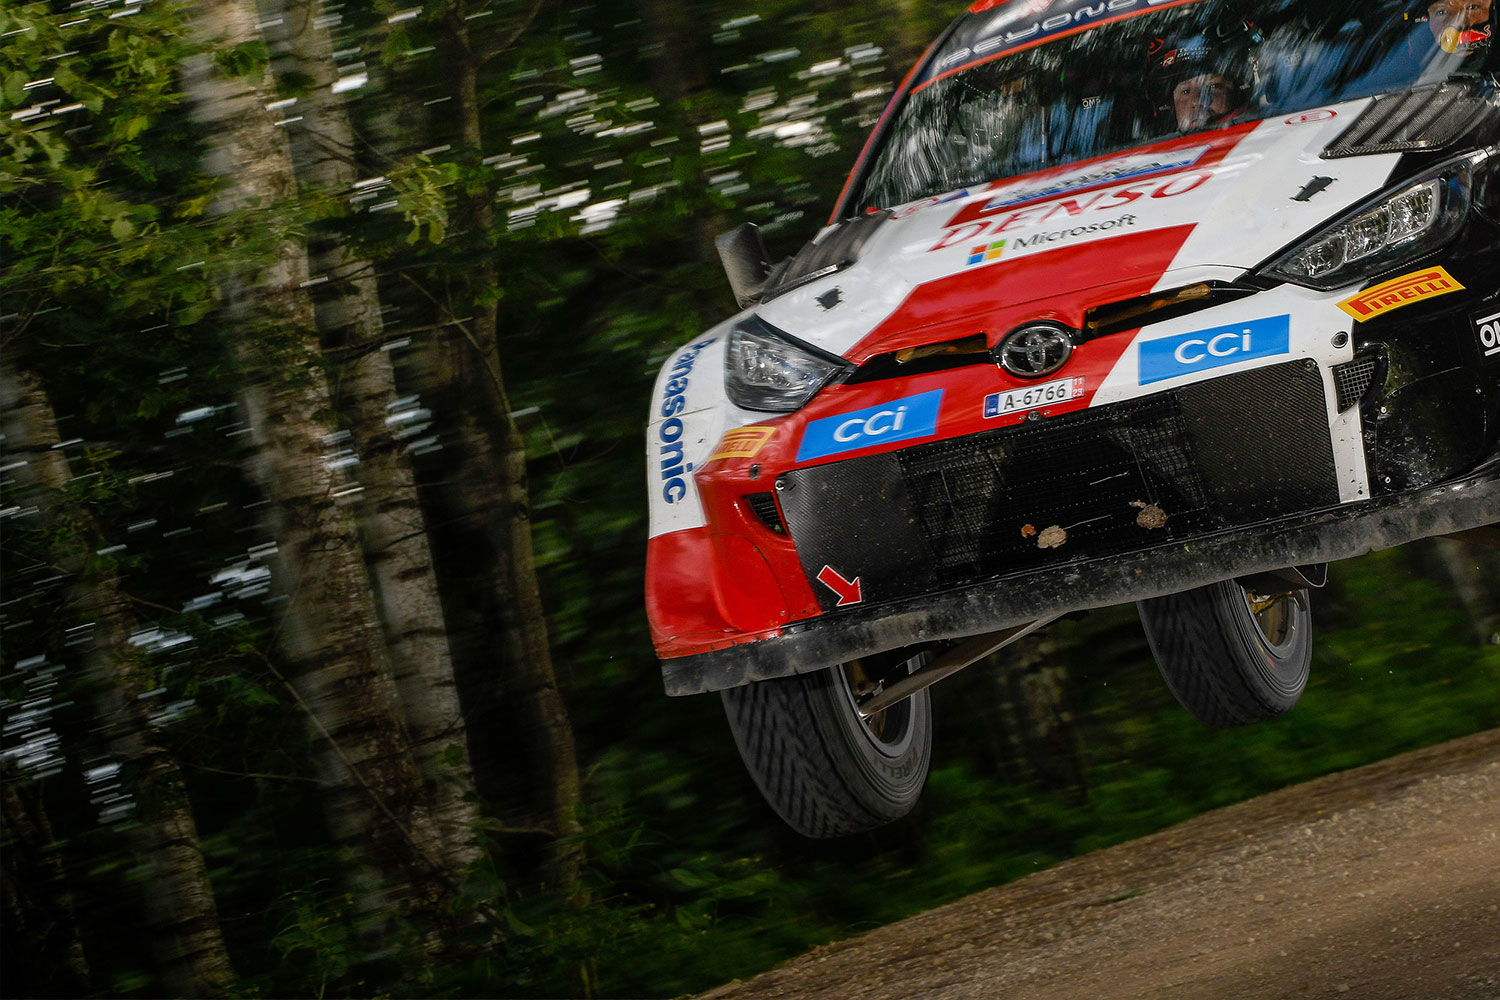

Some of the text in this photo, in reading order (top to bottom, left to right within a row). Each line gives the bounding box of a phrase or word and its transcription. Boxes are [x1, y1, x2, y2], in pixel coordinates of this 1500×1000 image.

[927, 171, 1216, 253] DENSO
[1012, 213, 1137, 251] Microsoft
[1346, 271, 1452, 316] PIRELLI
[1003, 383, 1067, 411] A-6766
[659, 336, 718, 504] Panasonic
